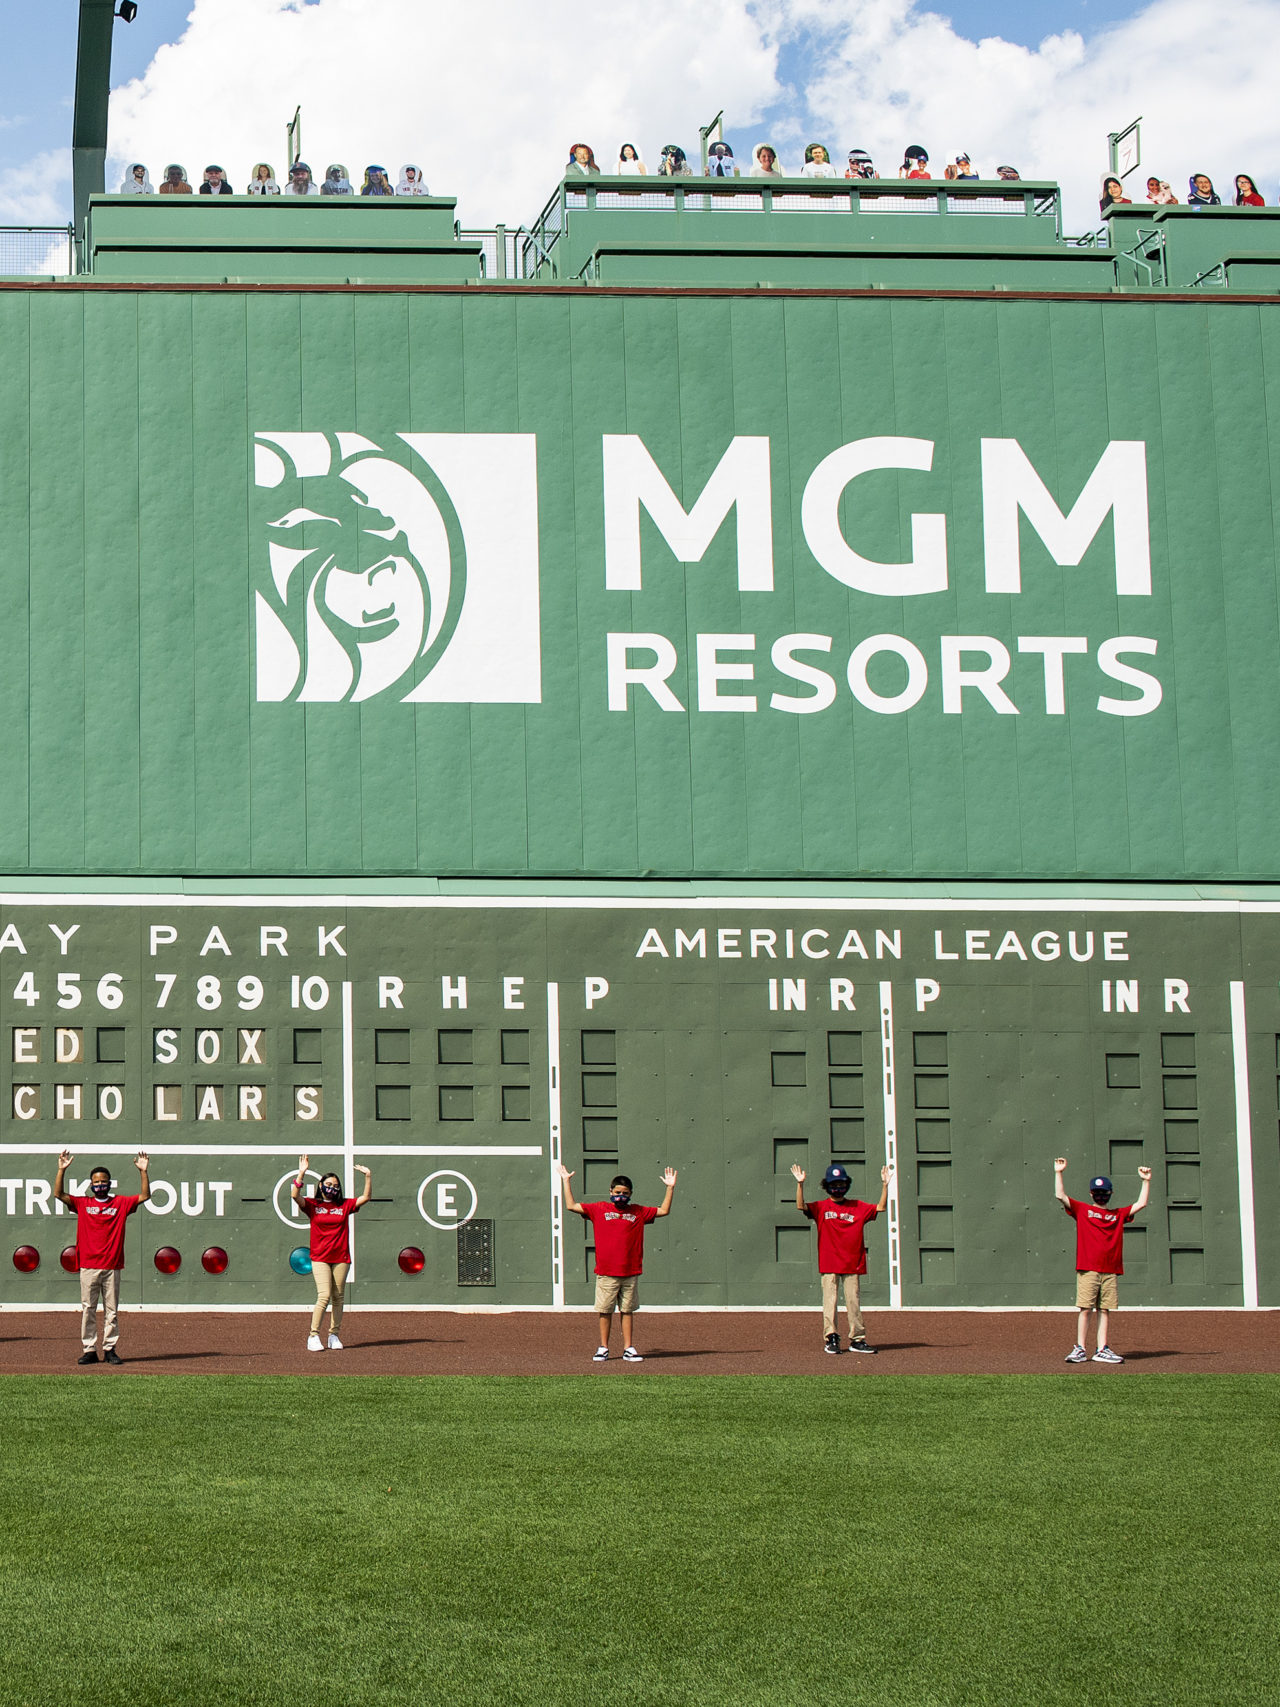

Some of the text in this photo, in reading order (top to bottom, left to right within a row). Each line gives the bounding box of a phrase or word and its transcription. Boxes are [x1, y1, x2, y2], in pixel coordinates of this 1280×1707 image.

[602, 433, 1152, 597] MGM
[607, 633, 1163, 717] RESORTS
[150, 925, 348, 957] PARK
[635, 928, 1129, 962] AMERICAN LEAGUE
[13, 972, 40, 1007] 4
[56, 973, 82, 1009] 5
[96, 973, 124, 1010] 6
[154, 974, 177, 1008] 7
[196, 975, 222, 1011] 8
[237, 975, 264, 1011] 9
[291, 975, 330, 1011] 10
[378, 976, 525, 1010] R H E
[585, 977, 857, 1011] P IN R
[915, 979, 1191, 1013] P IN R
[145, 1180, 233, 1217] OUT
[437, 1183, 458, 1217] E
